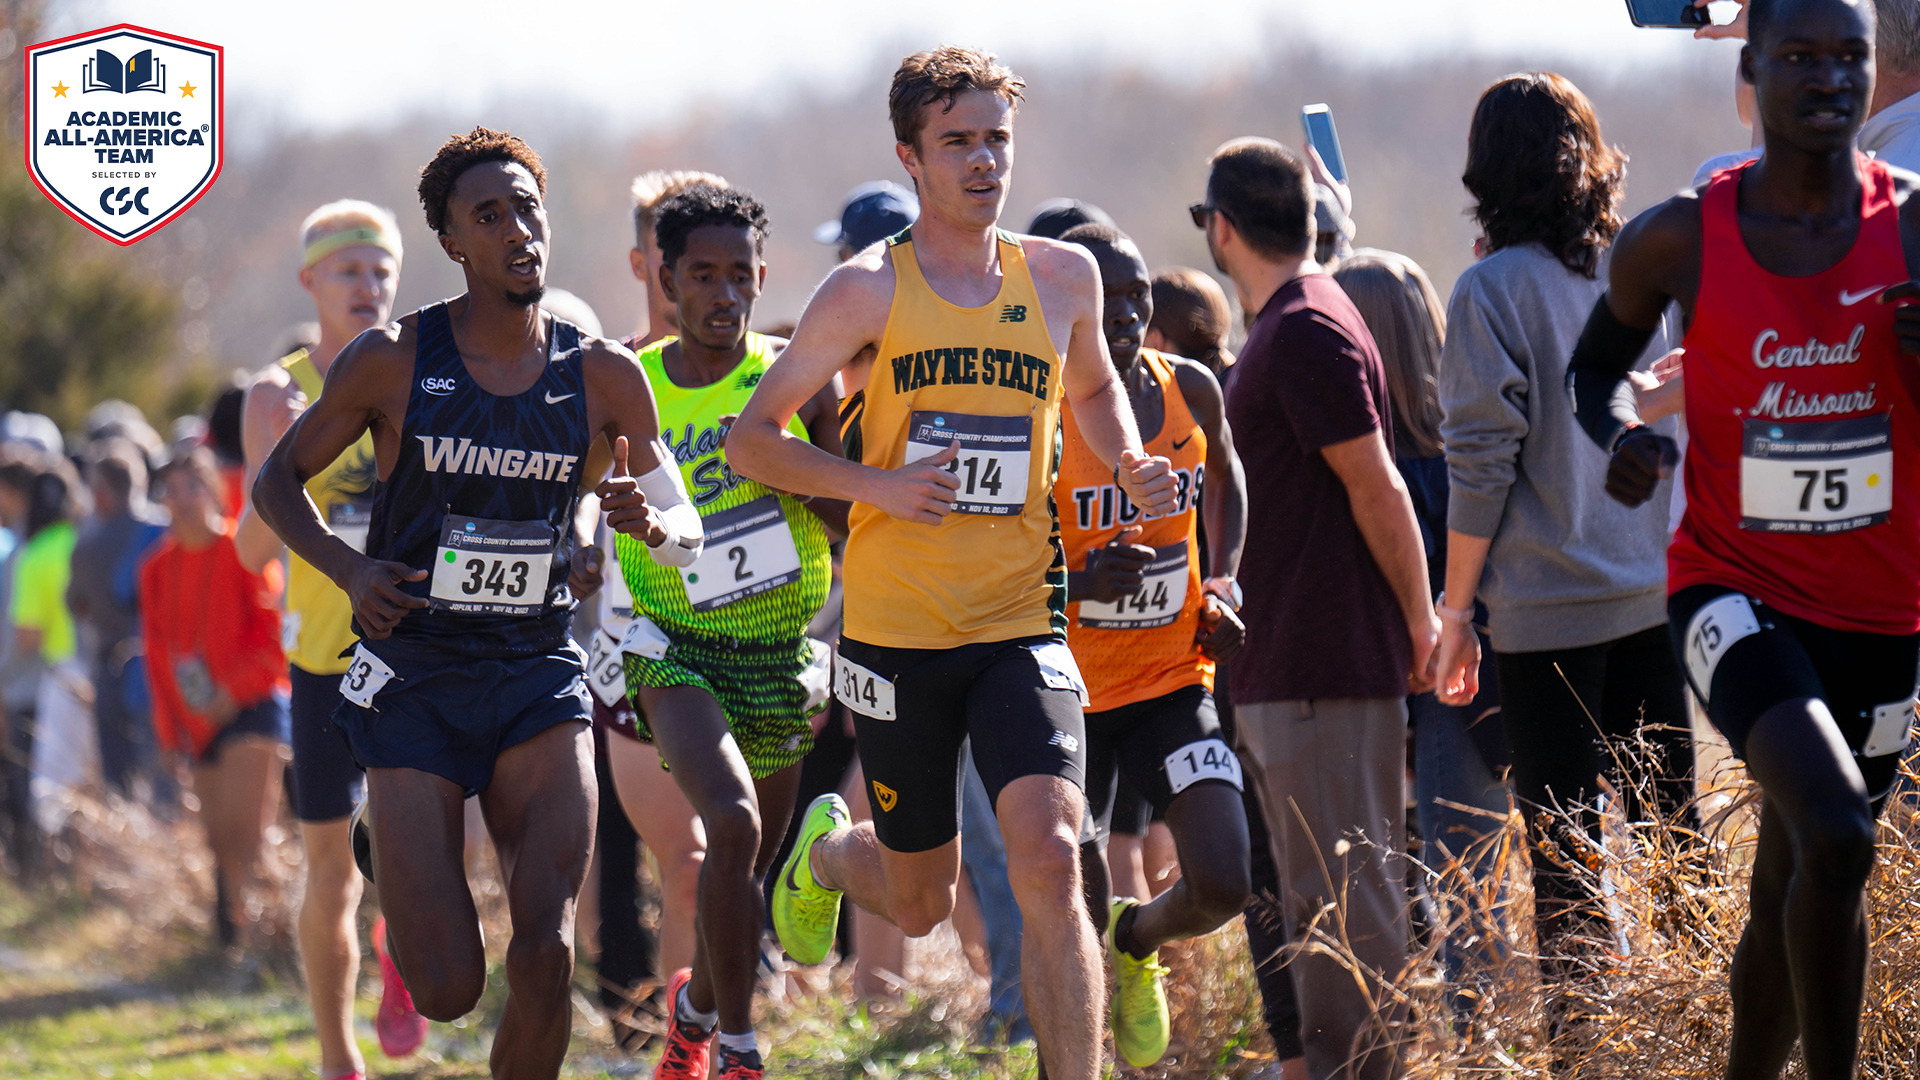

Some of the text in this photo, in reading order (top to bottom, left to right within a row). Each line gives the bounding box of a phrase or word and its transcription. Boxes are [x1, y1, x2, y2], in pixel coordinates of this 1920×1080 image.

[1752, 322, 1865, 369] Central
[426, 377, 456, 391] SAC
[891, 347, 1050, 401] WAYNE STATE
[1749, 381, 1877, 419] Missouri
[932, 430, 953, 439] CROSS
[953, 432, 982, 442] COUNTRY
[982, 434, 1028, 443] CHAMPIONSHIPS
[1770, 435, 1888, 452] CROSS COUNTRY CHAMPIONSHIPS
[415, 435, 579, 483] WINGATE
[969, 505, 982, 513] NOV
[1793, 468, 1848, 512] 75
[462, 535, 483, 544] CROSS
[483, 537, 509, 546] COUNTRY
[509, 538, 551, 546] CHAMPIONSHIPS
[461, 558, 529, 598] 343
[728, 546, 755, 582] 2
[1693, 614, 1723, 667] 75
[842, 665, 878, 708] 314
[1184, 746, 1234, 774] 144
